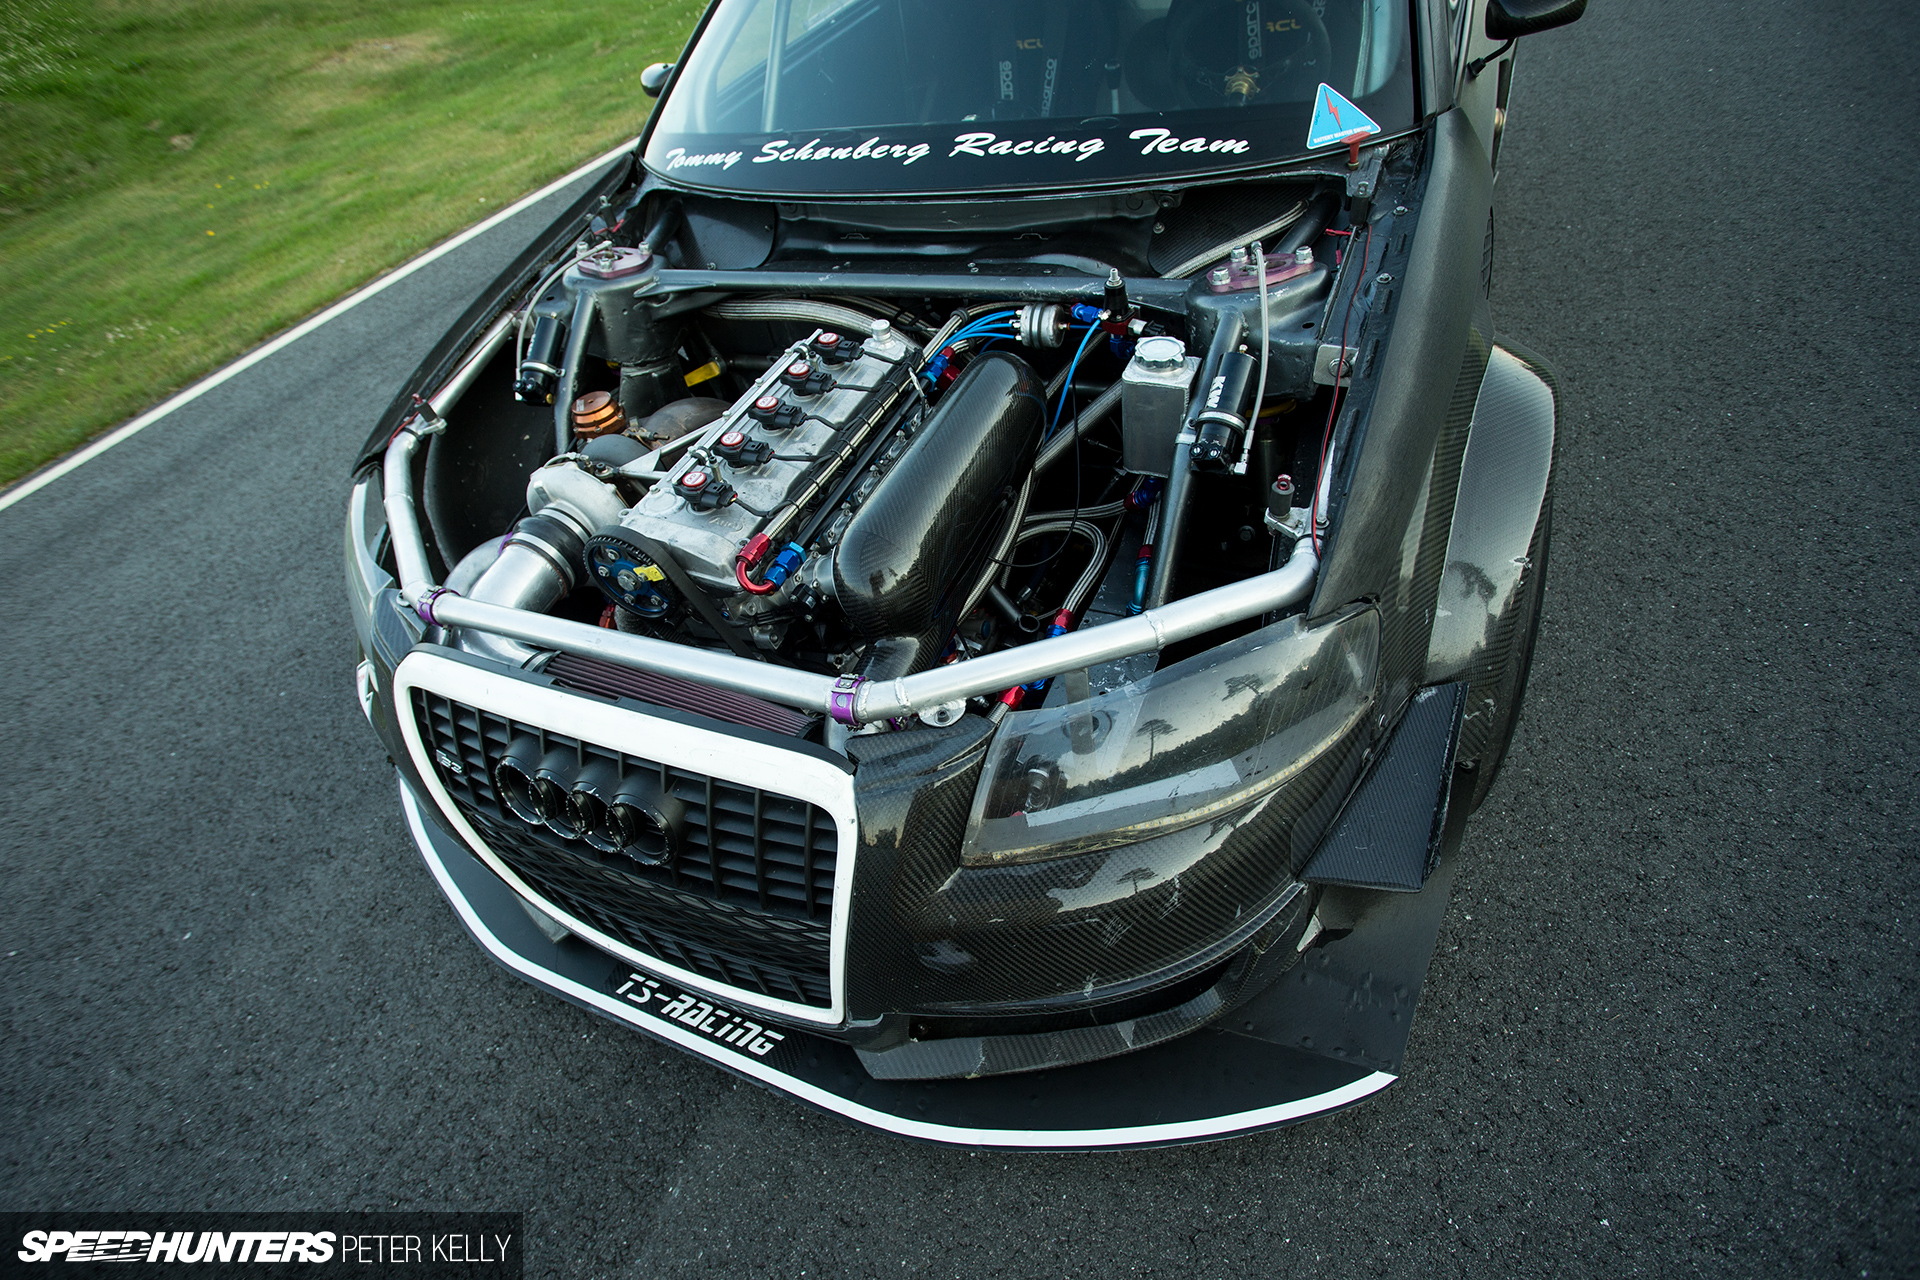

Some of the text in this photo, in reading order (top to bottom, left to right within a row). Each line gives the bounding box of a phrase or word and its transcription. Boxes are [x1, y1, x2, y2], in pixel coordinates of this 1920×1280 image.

[665, 147, 743, 171] Tommy
[948, 132, 1106, 162] Racing
[1128, 127, 1251, 156] Team
[1206, 376, 1226, 408] KW
[615, 972, 786, 1056] TS-RACING
